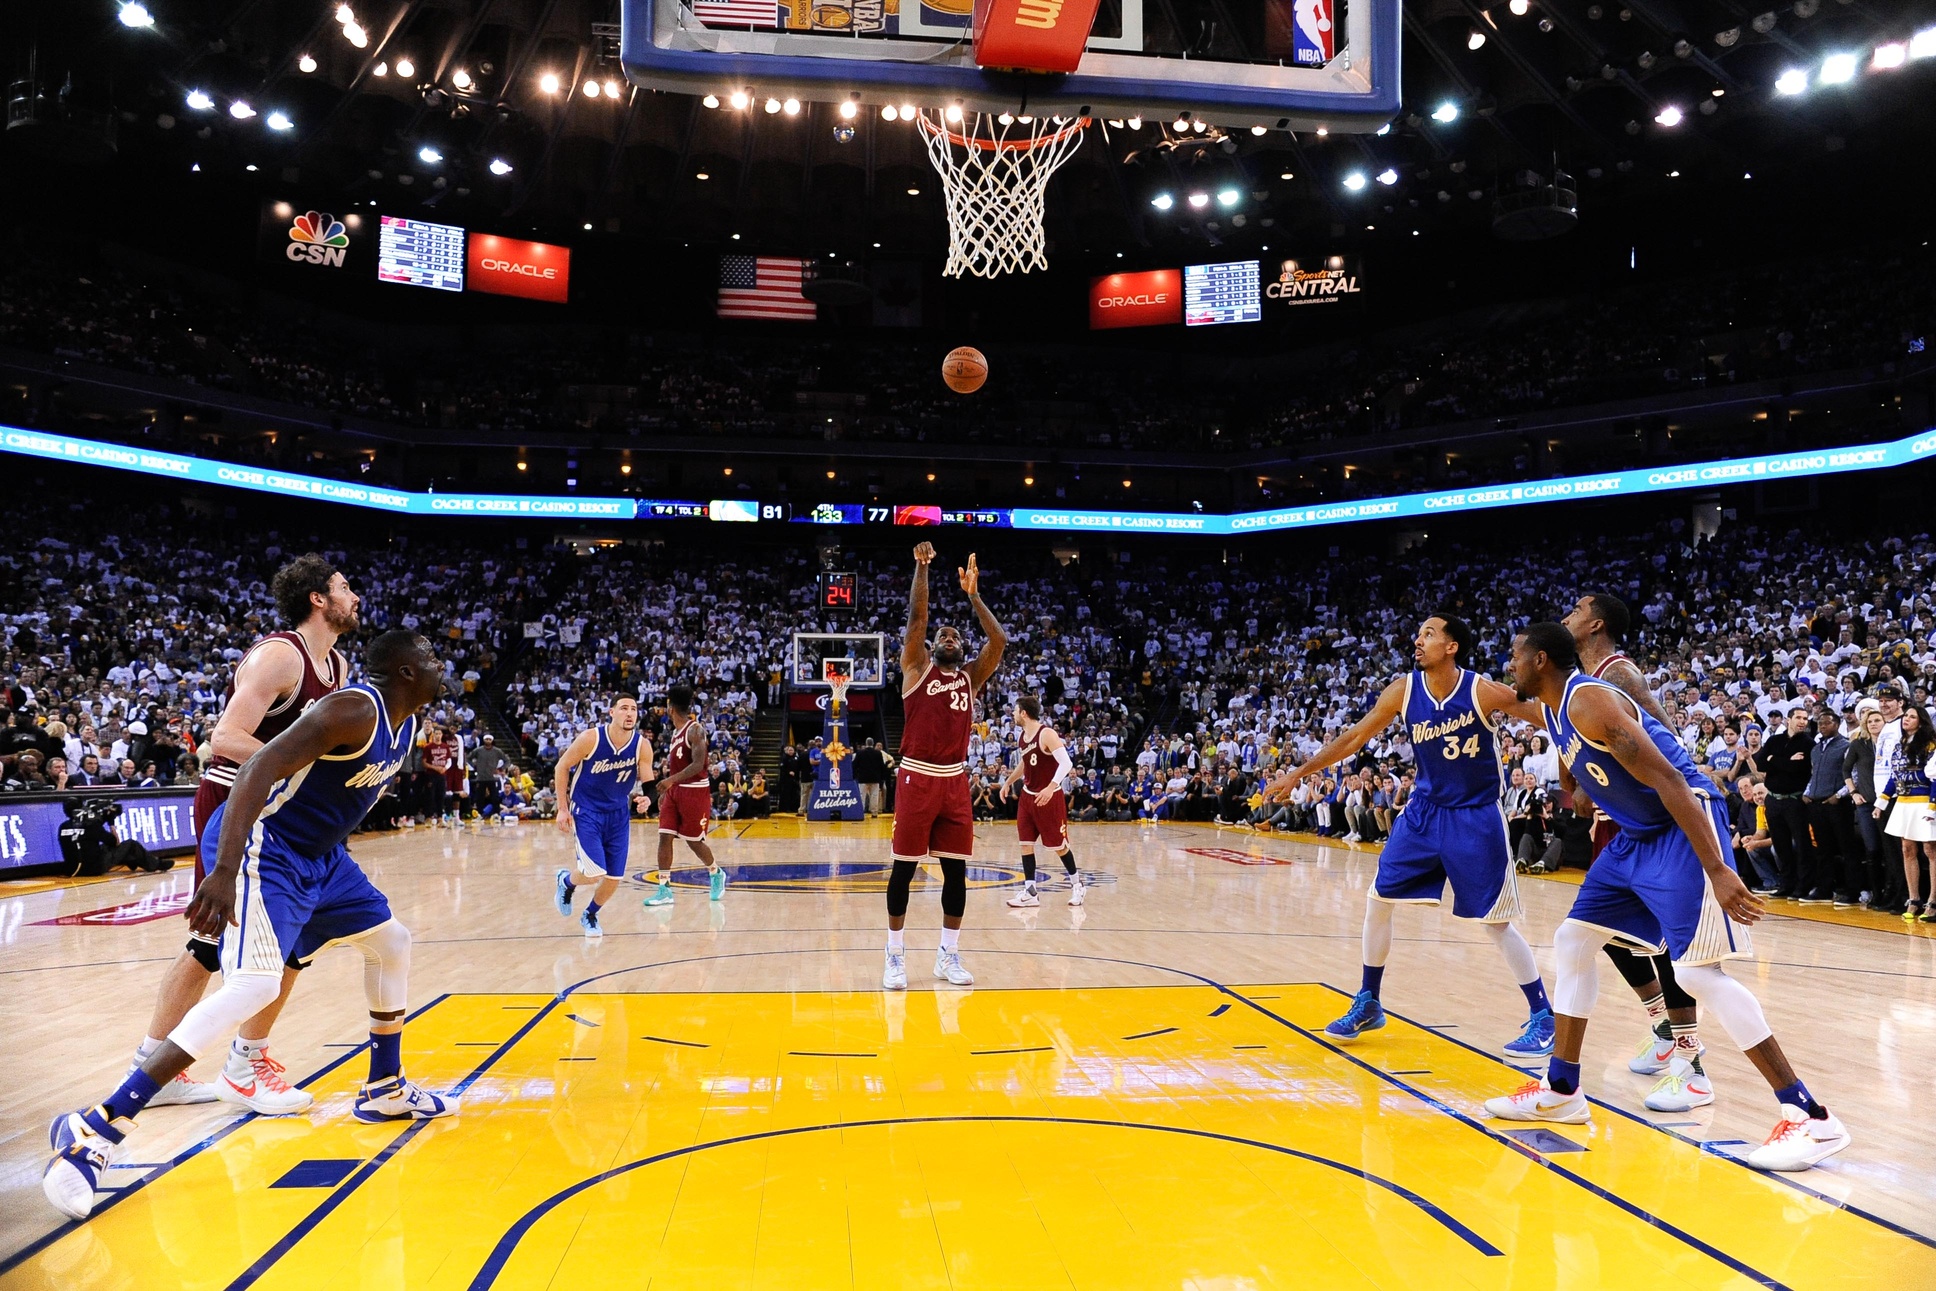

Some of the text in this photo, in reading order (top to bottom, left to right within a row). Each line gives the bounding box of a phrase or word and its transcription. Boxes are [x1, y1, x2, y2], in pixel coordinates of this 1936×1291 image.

[1298, 48, 1321, 62] NBA
[286, 241, 347, 267] CSN
[481, 258, 556, 279] ORACLE
[1266, 277, 1361, 299] CENTRAL
[1098, 293, 1168, 308] ORACLE
[5, 433, 62, 453] CREEK
[80, 446, 138, 465] CASINO
[140, 455, 191, 473] RESORT
[1648, 449, 1886, 485] CACHE CREEK CASINO RESORT
[217, 467, 410, 507] CACHE CREEK CASINO RESORT
[1423, 477, 1621, 508] CACHE CREEK CASINO RESORT
[431, 498, 620, 514] CACHE CREEK CASINO RESORT
[763, 505, 783, 519] 81
[868, 508, 889, 521] 77
[1231, 501, 1398, 529] CACHE CREEK CASINO RESORT
[811, 510, 843, 523] 1:33
[956, 513, 965, 522] 2
[1030, 514, 1204, 529] CACHE CREEK CASINO RESORT
[827, 586, 851, 605] 24
[950, 690, 969, 712] 23
[1411, 710, 1476, 744] Warriors
[676, 746, 684, 760] 4
[1442, 734, 1481, 760] 34
[591, 756, 636, 774] Warriors
[1030, 753, 1038, 766] 8
[615, 769, 632, 784] 11
[1585, 761, 1610, 787] 9
[819, 789, 852, 798] HAPPY
[813, 797, 858, 809] holidays
[159, 805, 180, 841] ET
